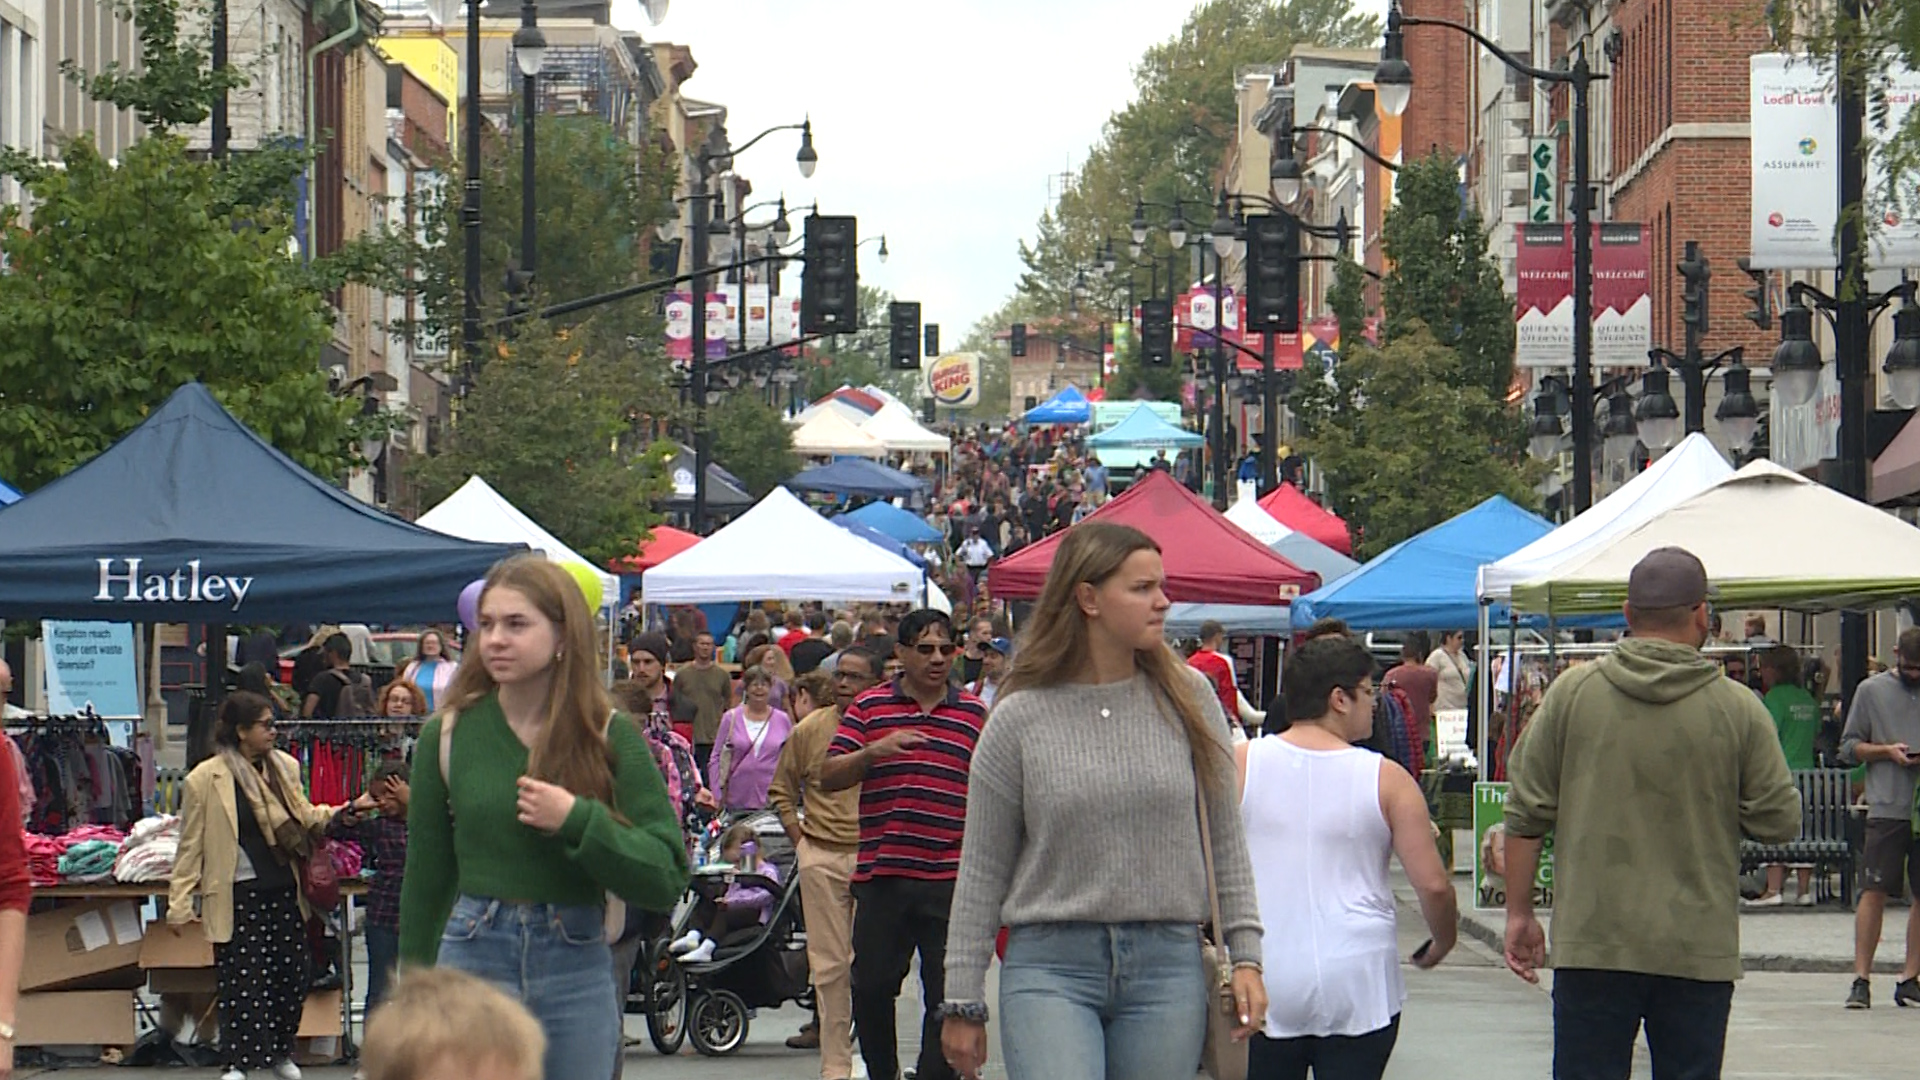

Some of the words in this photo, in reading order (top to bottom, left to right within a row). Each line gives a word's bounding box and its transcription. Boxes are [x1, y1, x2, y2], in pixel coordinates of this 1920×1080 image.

[1763, 94, 1794, 105] Local
[1763, 160, 1821, 169] ASSURANT
[1520, 271, 1571, 279] WELCOME
[1596, 270, 1645, 279] WELCOME
[935, 374, 970, 391] KING
[94, 558, 254, 611] Hatley
[54, 629, 87, 641] Kingston
[80, 645, 98, 655] cent
[100, 645, 122, 655] waste
